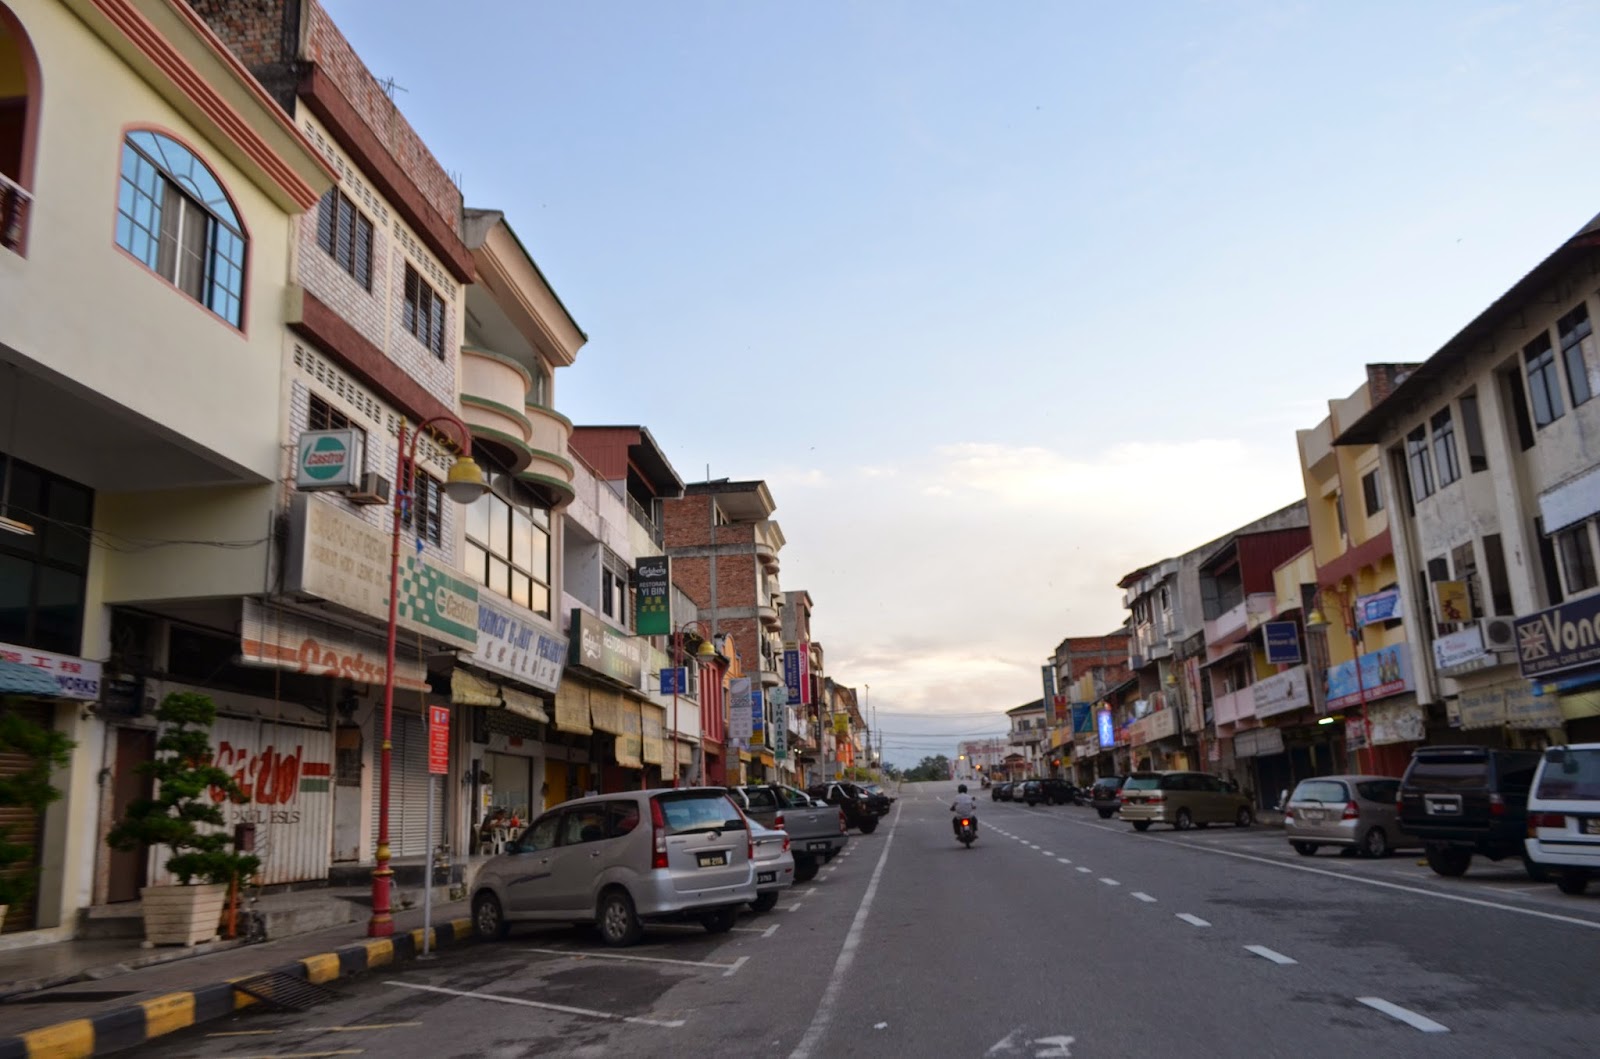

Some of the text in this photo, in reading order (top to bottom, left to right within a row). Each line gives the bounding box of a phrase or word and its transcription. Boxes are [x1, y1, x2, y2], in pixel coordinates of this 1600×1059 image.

[307, 452, 346, 465] Castrol
[639, 566, 666, 578] Carlsberg
[641, 587, 665, 596] YI BIN
[446, 595, 477, 624] Castrol
